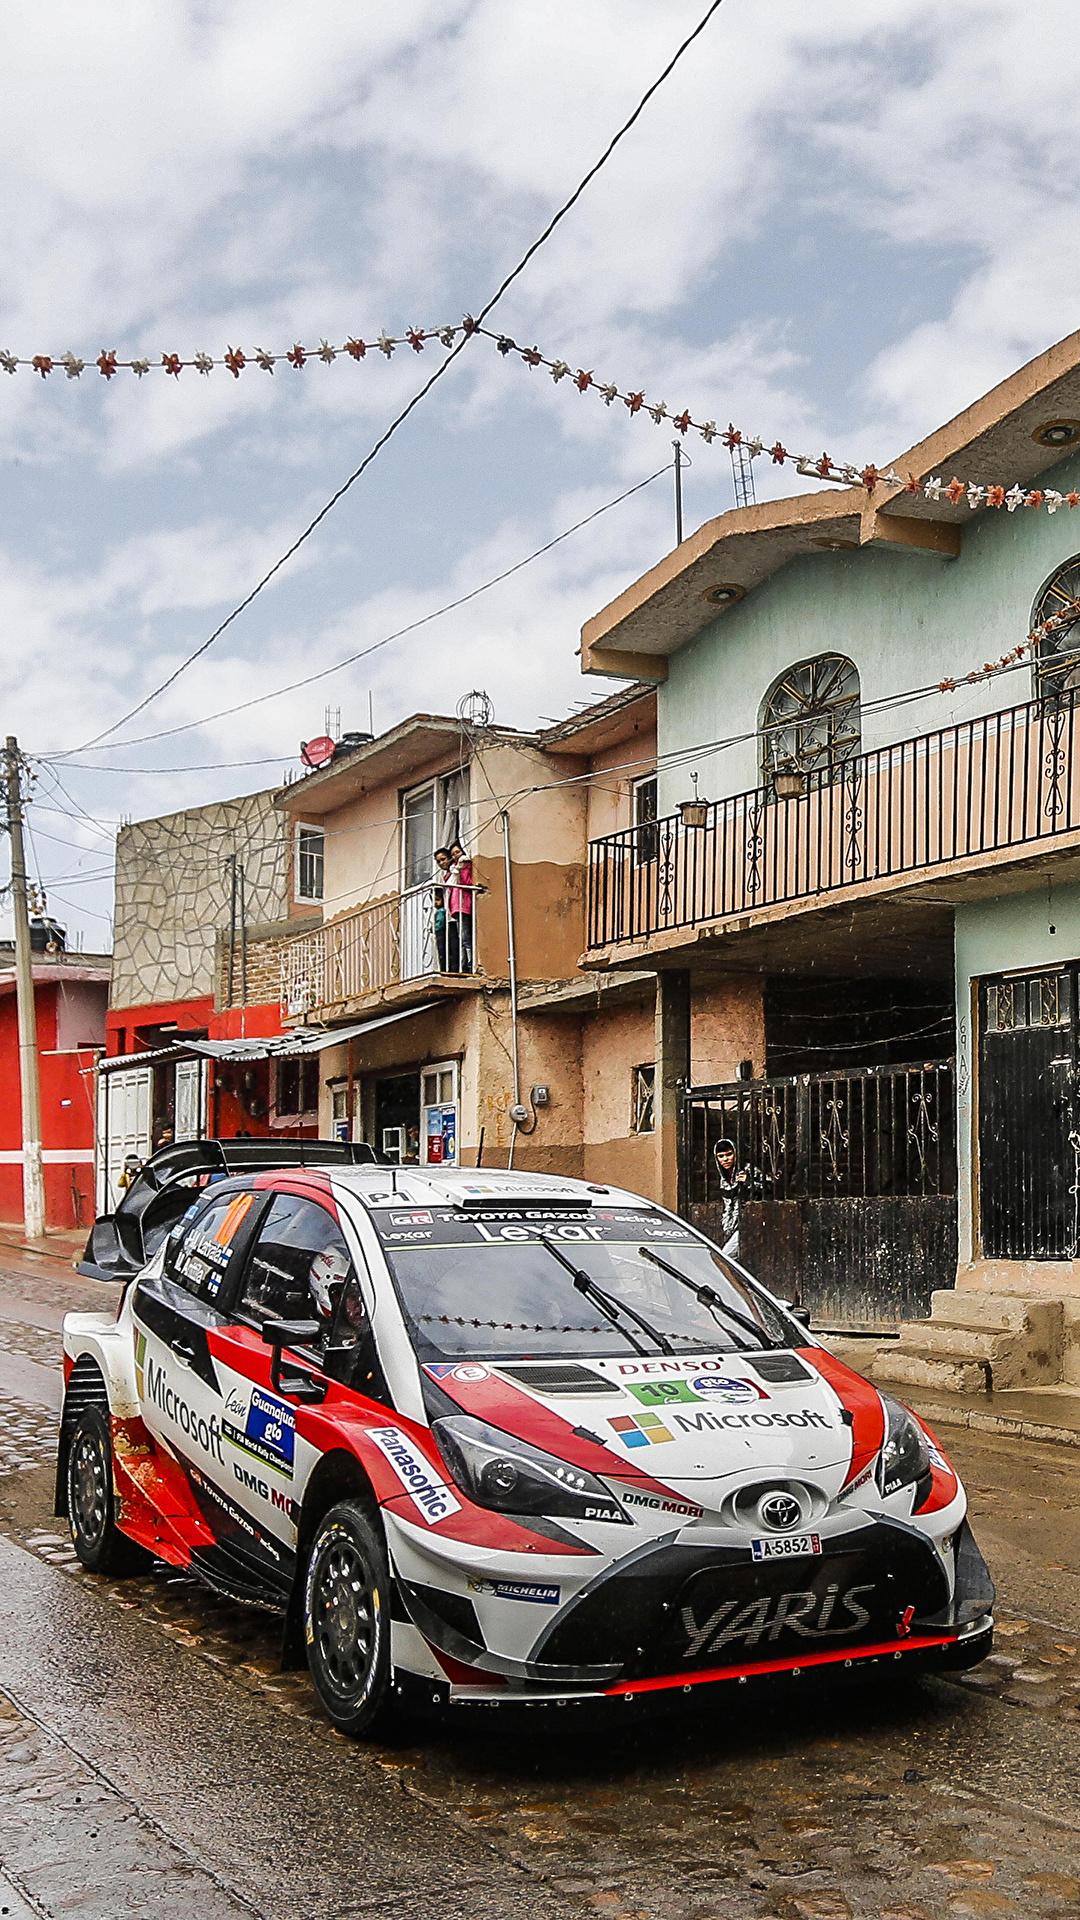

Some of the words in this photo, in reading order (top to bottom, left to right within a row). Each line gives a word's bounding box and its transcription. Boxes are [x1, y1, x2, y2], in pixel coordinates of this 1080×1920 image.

[368, 1192, 410, 1203] P1
[495, 1186, 578, 1194] Microsoft
[394, 1215, 430, 1225] GR
[437, 1212, 523, 1222] TOYOTA
[526, 1211, 596, 1221] GAZOO
[601, 1213, 663, 1225] Racing
[380, 1230, 432, 1241] Lexar
[474, 1223, 603, 1241] Lexar
[645, 1228, 689, 1239] Lexar
[618, 1361, 721, 1375] DENSO
[640, 1384, 679, 1397] 10
[148, 1358, 225, 1466] Microsoft
[672, 1409, 833, 1433] Microsoft
[265, 1423, 282, 1441] gto
[372, 1428, 448, 1517] Panasonic
[233, 1462, 269, 1500] DMG
[202, 1480, 228, 1512] TOYOTA
[585, 1507, 623, 1520] PIAA
[622, 1493, 660, 1509] DMG
[661, 1501, 704, 1518] MORI
[764, 1537, 809, 1556] A-5852
[498, 1585, 558, 1598] MICHELIN
[682, 1584, 876, 1657] YARIS
